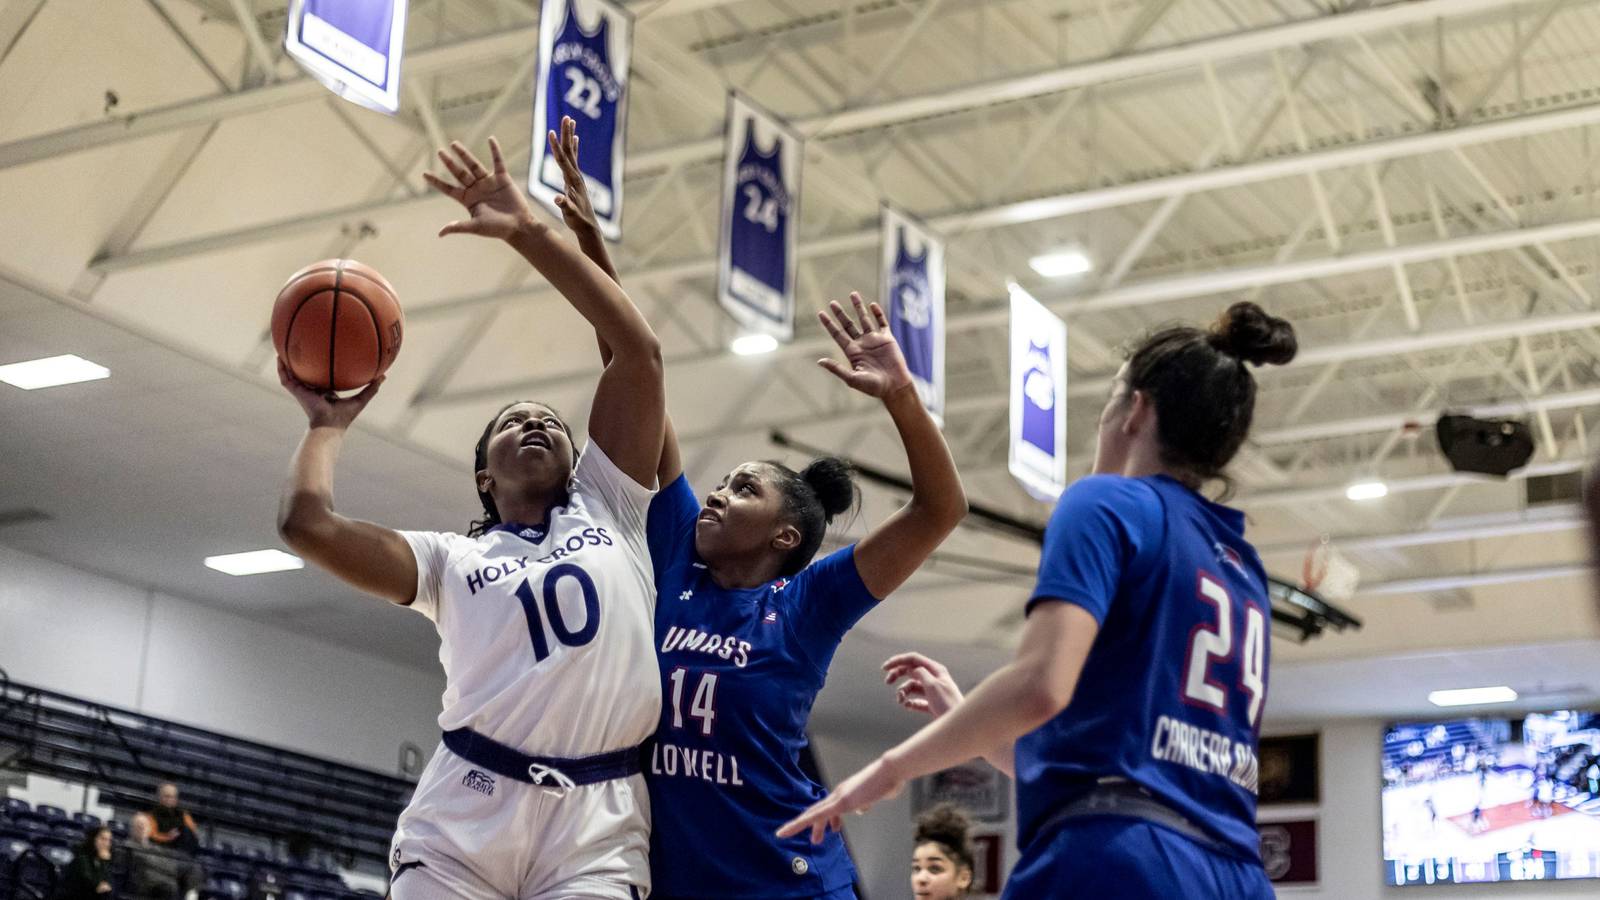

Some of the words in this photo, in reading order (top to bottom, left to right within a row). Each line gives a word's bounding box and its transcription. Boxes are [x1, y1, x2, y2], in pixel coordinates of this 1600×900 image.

[563, 65, 602, 119] 22
[743, 184, 779, 233] 24
[466, 556, 528, 595] HOLY
[537, 528, 613, 564] CROSS
[515, 563, 600, 662] 10
[661, 626, 752, 668] UMASS
[1184, 572, 1265, 728] 24
[669, 667, 719, 736] 14
[652, 742, 744, 786] LOWELL
